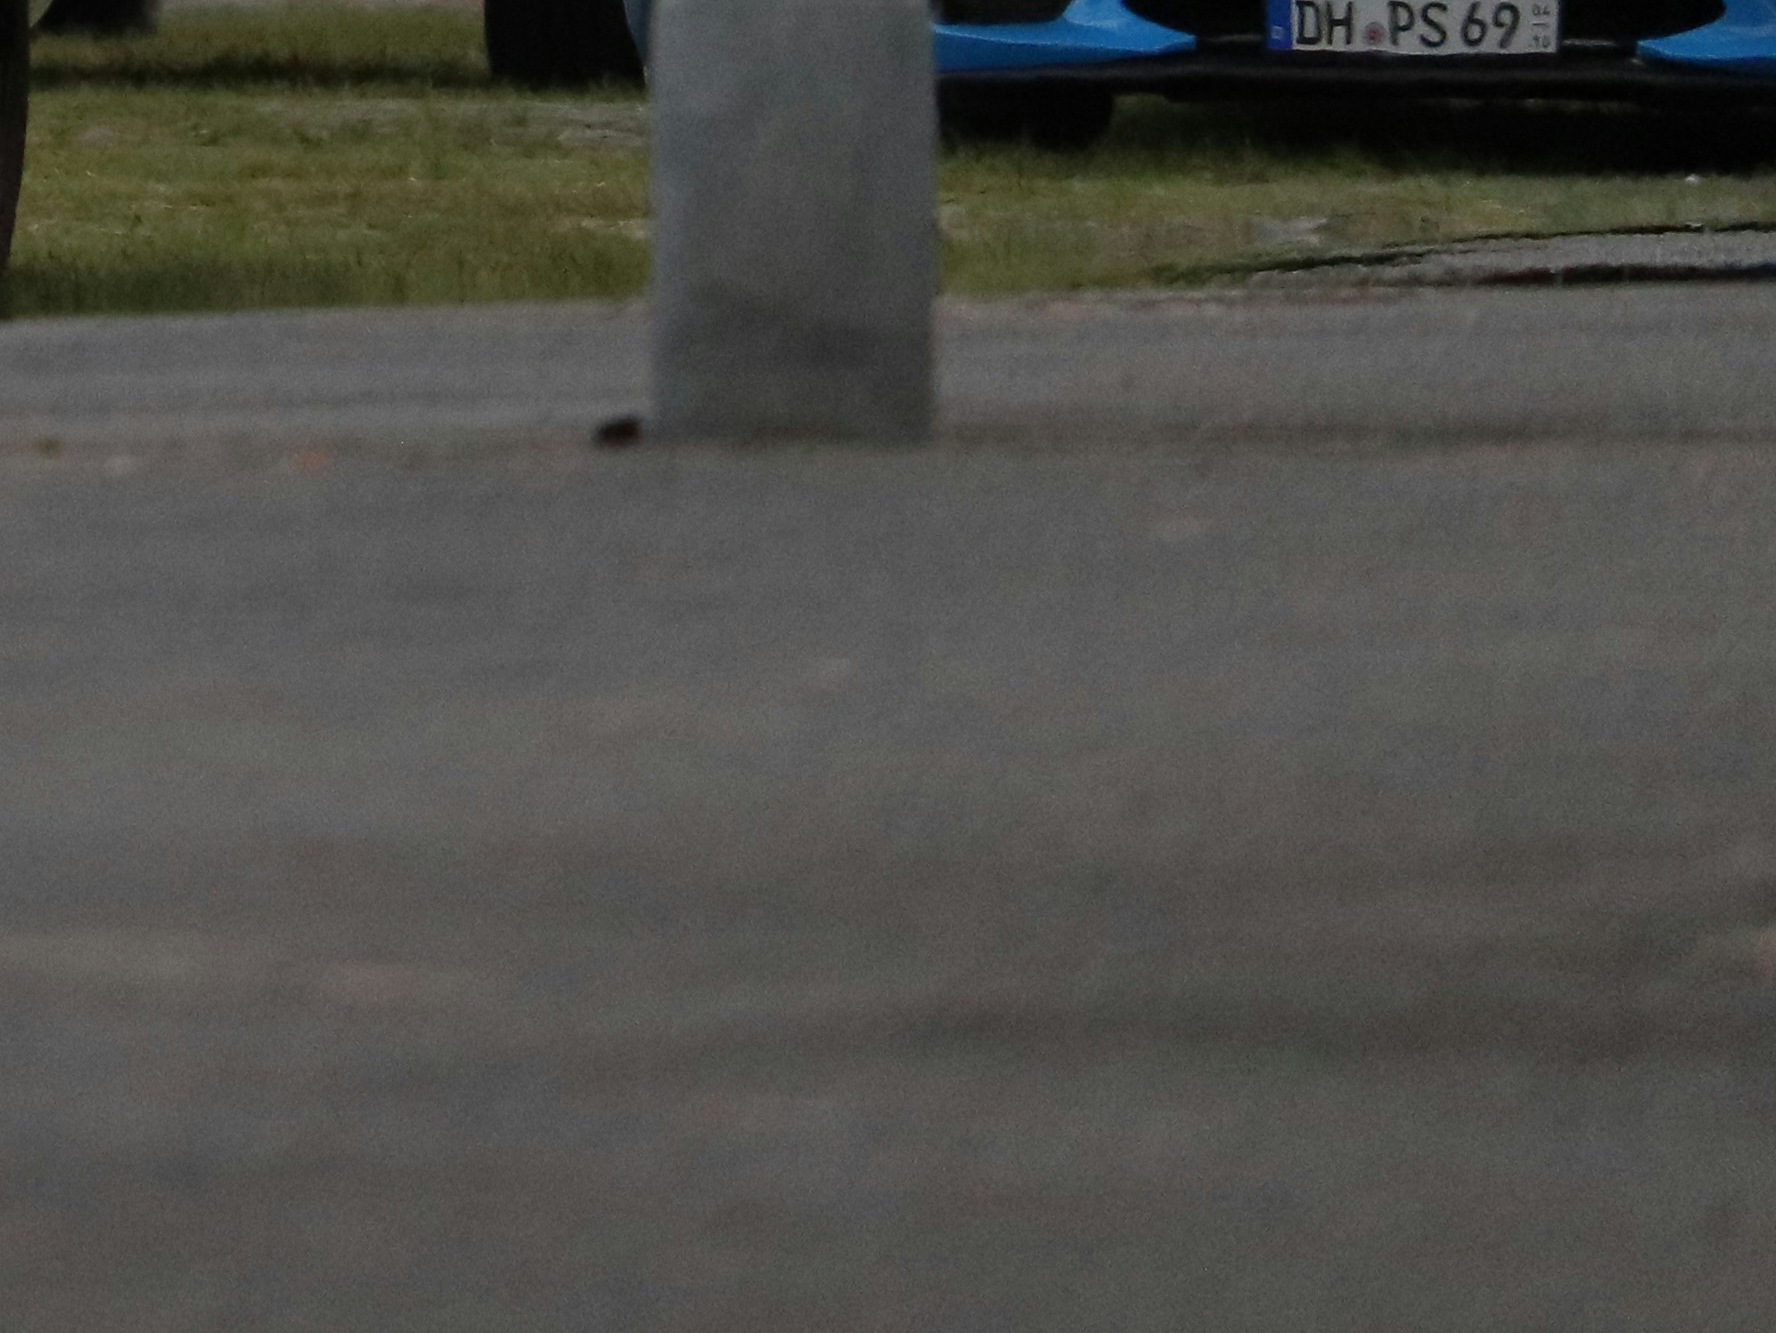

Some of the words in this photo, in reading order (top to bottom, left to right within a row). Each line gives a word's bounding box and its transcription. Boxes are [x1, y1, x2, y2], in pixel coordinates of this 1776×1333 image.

[1295, 0, 1353, 46] DH
[1388, 0, 1448, 48] PS
[1461, 1, 1521, 49] 69
